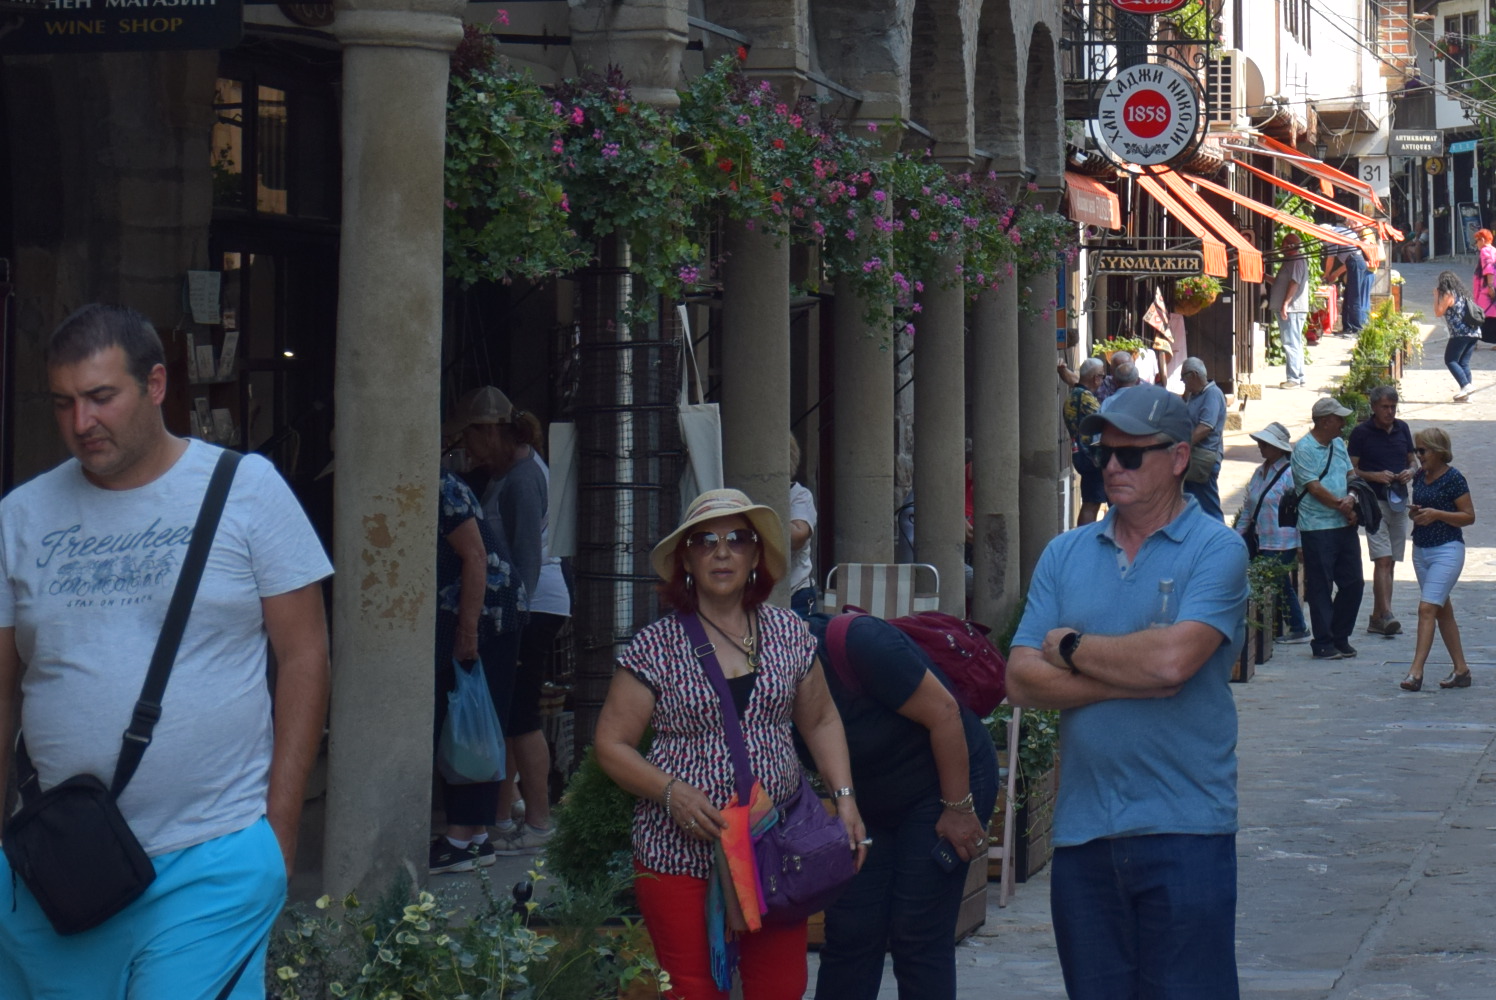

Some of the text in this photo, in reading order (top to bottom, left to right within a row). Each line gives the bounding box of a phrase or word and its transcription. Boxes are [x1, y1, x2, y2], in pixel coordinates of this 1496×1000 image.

[45, 17, 183, 35] WINE SHOP
[1102, 68, 1193, 146] ХАН ХАДЖИ НИКОЛИ
[1128, 105, 1167, 122] 1858
[1401, 143, 1432, 151] ANTIQUES
[1363, 165, 1382, 182] 31
[67, 594, 152, 609] STAY ON TRACK
